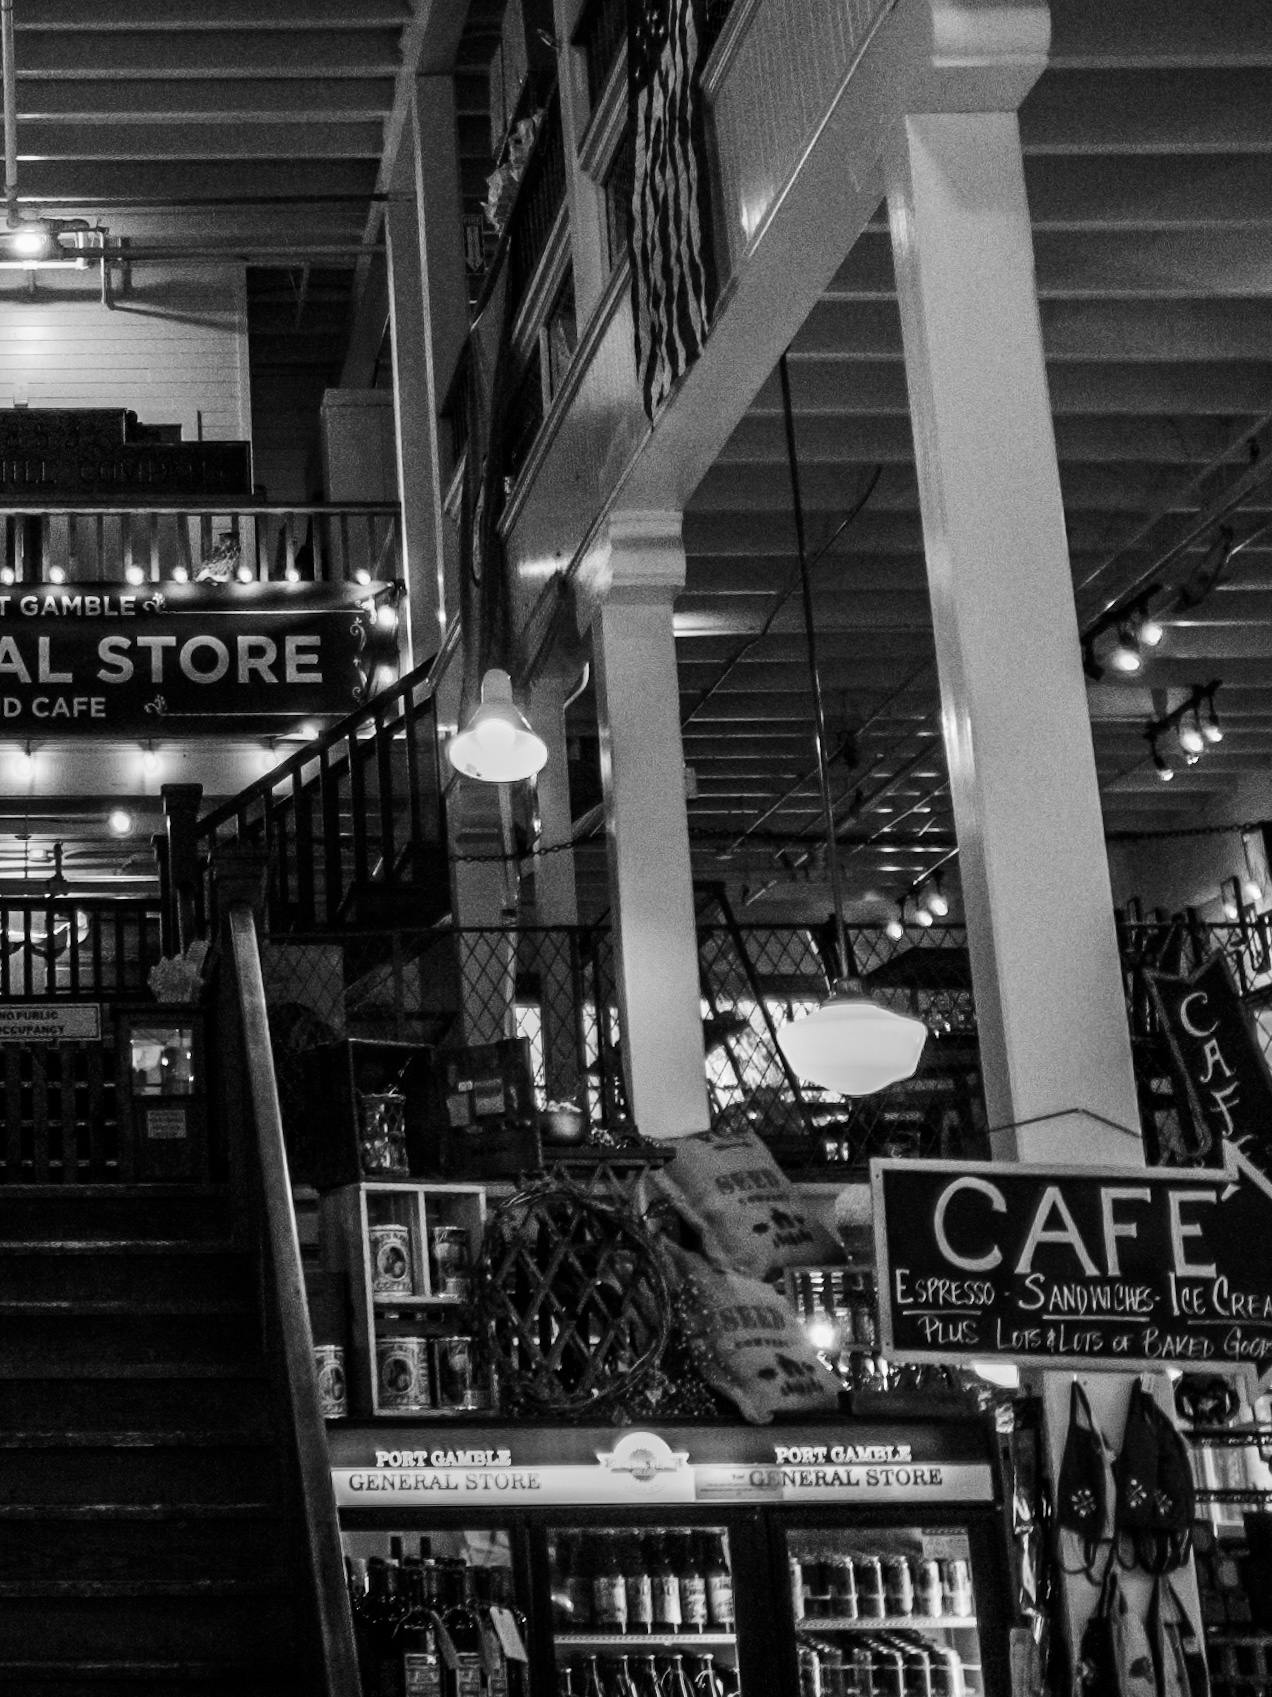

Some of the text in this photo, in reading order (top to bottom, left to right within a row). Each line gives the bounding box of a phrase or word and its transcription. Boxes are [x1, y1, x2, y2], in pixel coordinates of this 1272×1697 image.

[19, 595, 137, 616] GAMBLE
[96, 635, 324, 684] STORE
[31, 697, 107, 718] CAFE
[376, 1449, 512, 1468] PORT GAMBLE
[774, 1444, 913, 1464] PORT GAMBLE
[348, 1472, 543, 1492] GENERAL STORE
[748, 1468, 860, 1488] GENERAL
[865, 1468, 944, 1487] STORE
